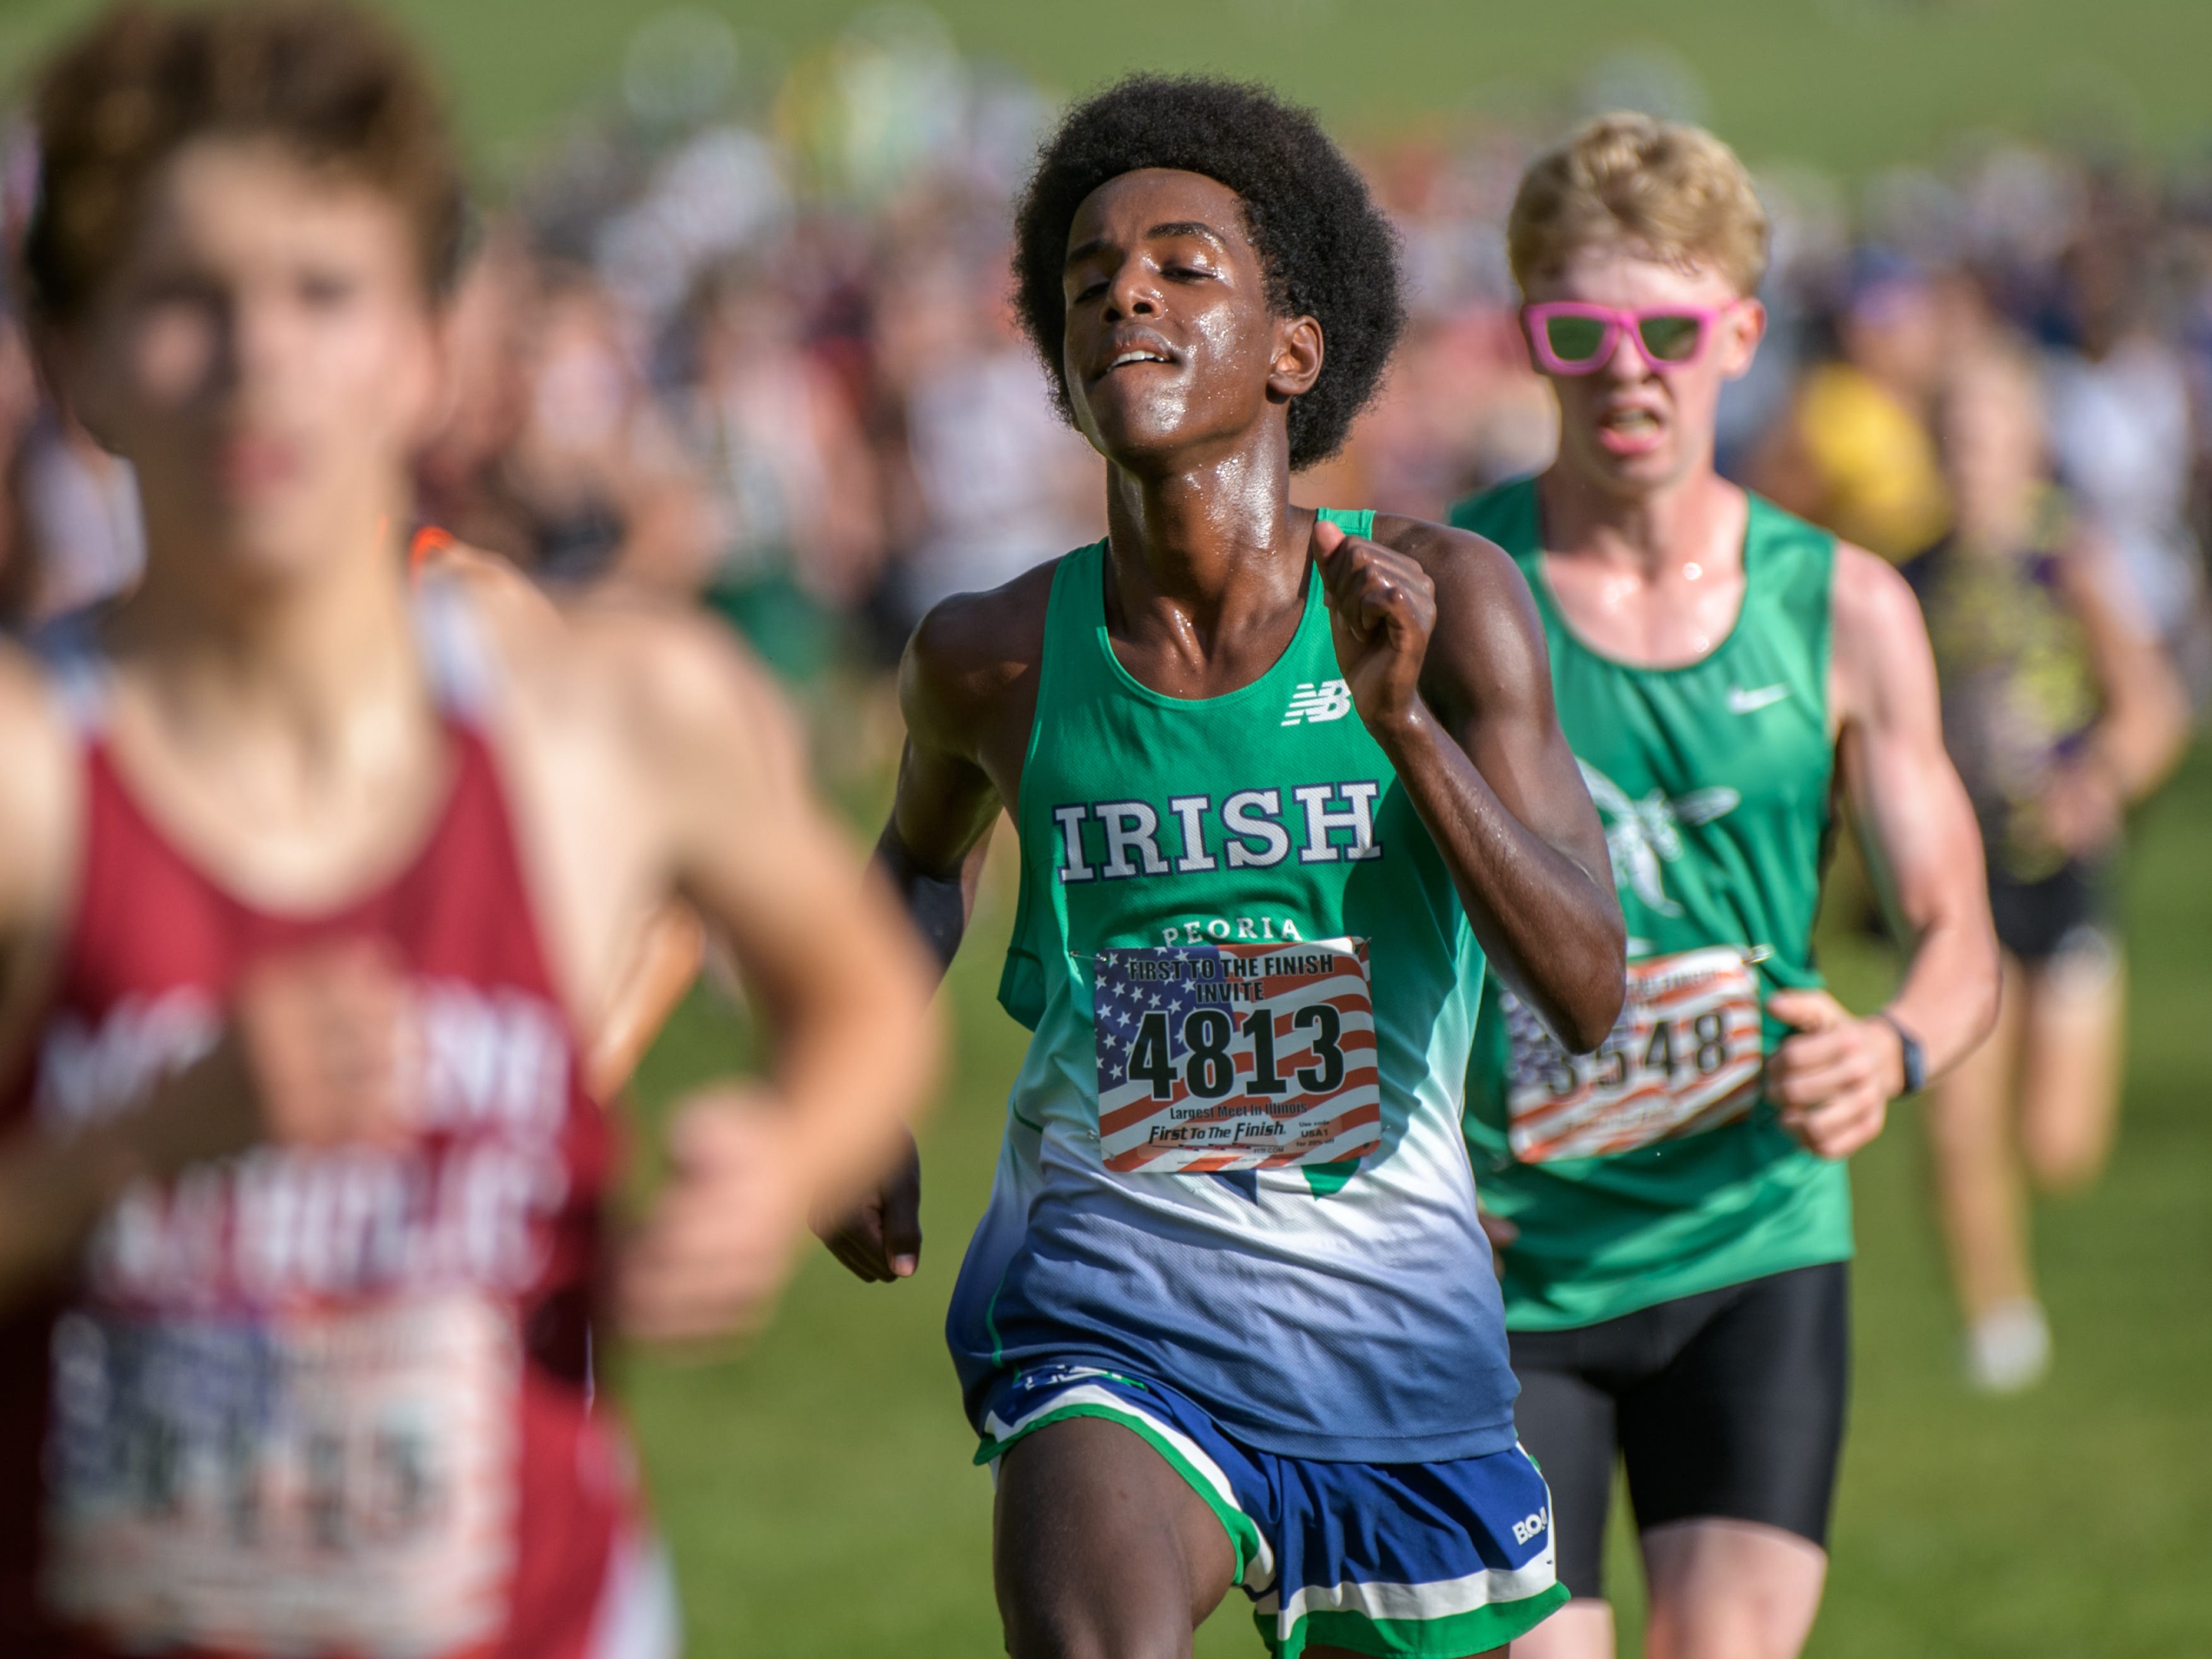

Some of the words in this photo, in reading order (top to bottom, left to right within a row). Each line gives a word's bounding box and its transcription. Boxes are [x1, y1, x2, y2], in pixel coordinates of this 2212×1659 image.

[1281, 678, 1351, 727] NB
[1052, 779, 1384, 885] IRISH
[1162, 917, 1303, 947] PEORIA
[1129, 960, 1183, 982] FIRST
[1187, 958, 1216, 980] TO
[1221, 957, 1259, 978] THE
[1264, 954, 1334, 976] FINISH
[1196, 982, 1264, 1004] INVITE
[1127, 1004, 1345, 1101] 4813
[1170, 1106, 1215, 1120] Largest
[1218, 1105, 1247, 1118] Meet
[1250, 1103, 1261, 1115] In
[1265, 1103, 1308, 1115] Illinois
[1148, 1125, 1189, 1144] First
[1191, 1127, 1206, 1140] To
[1208, 1127, 1232, 1139] The
